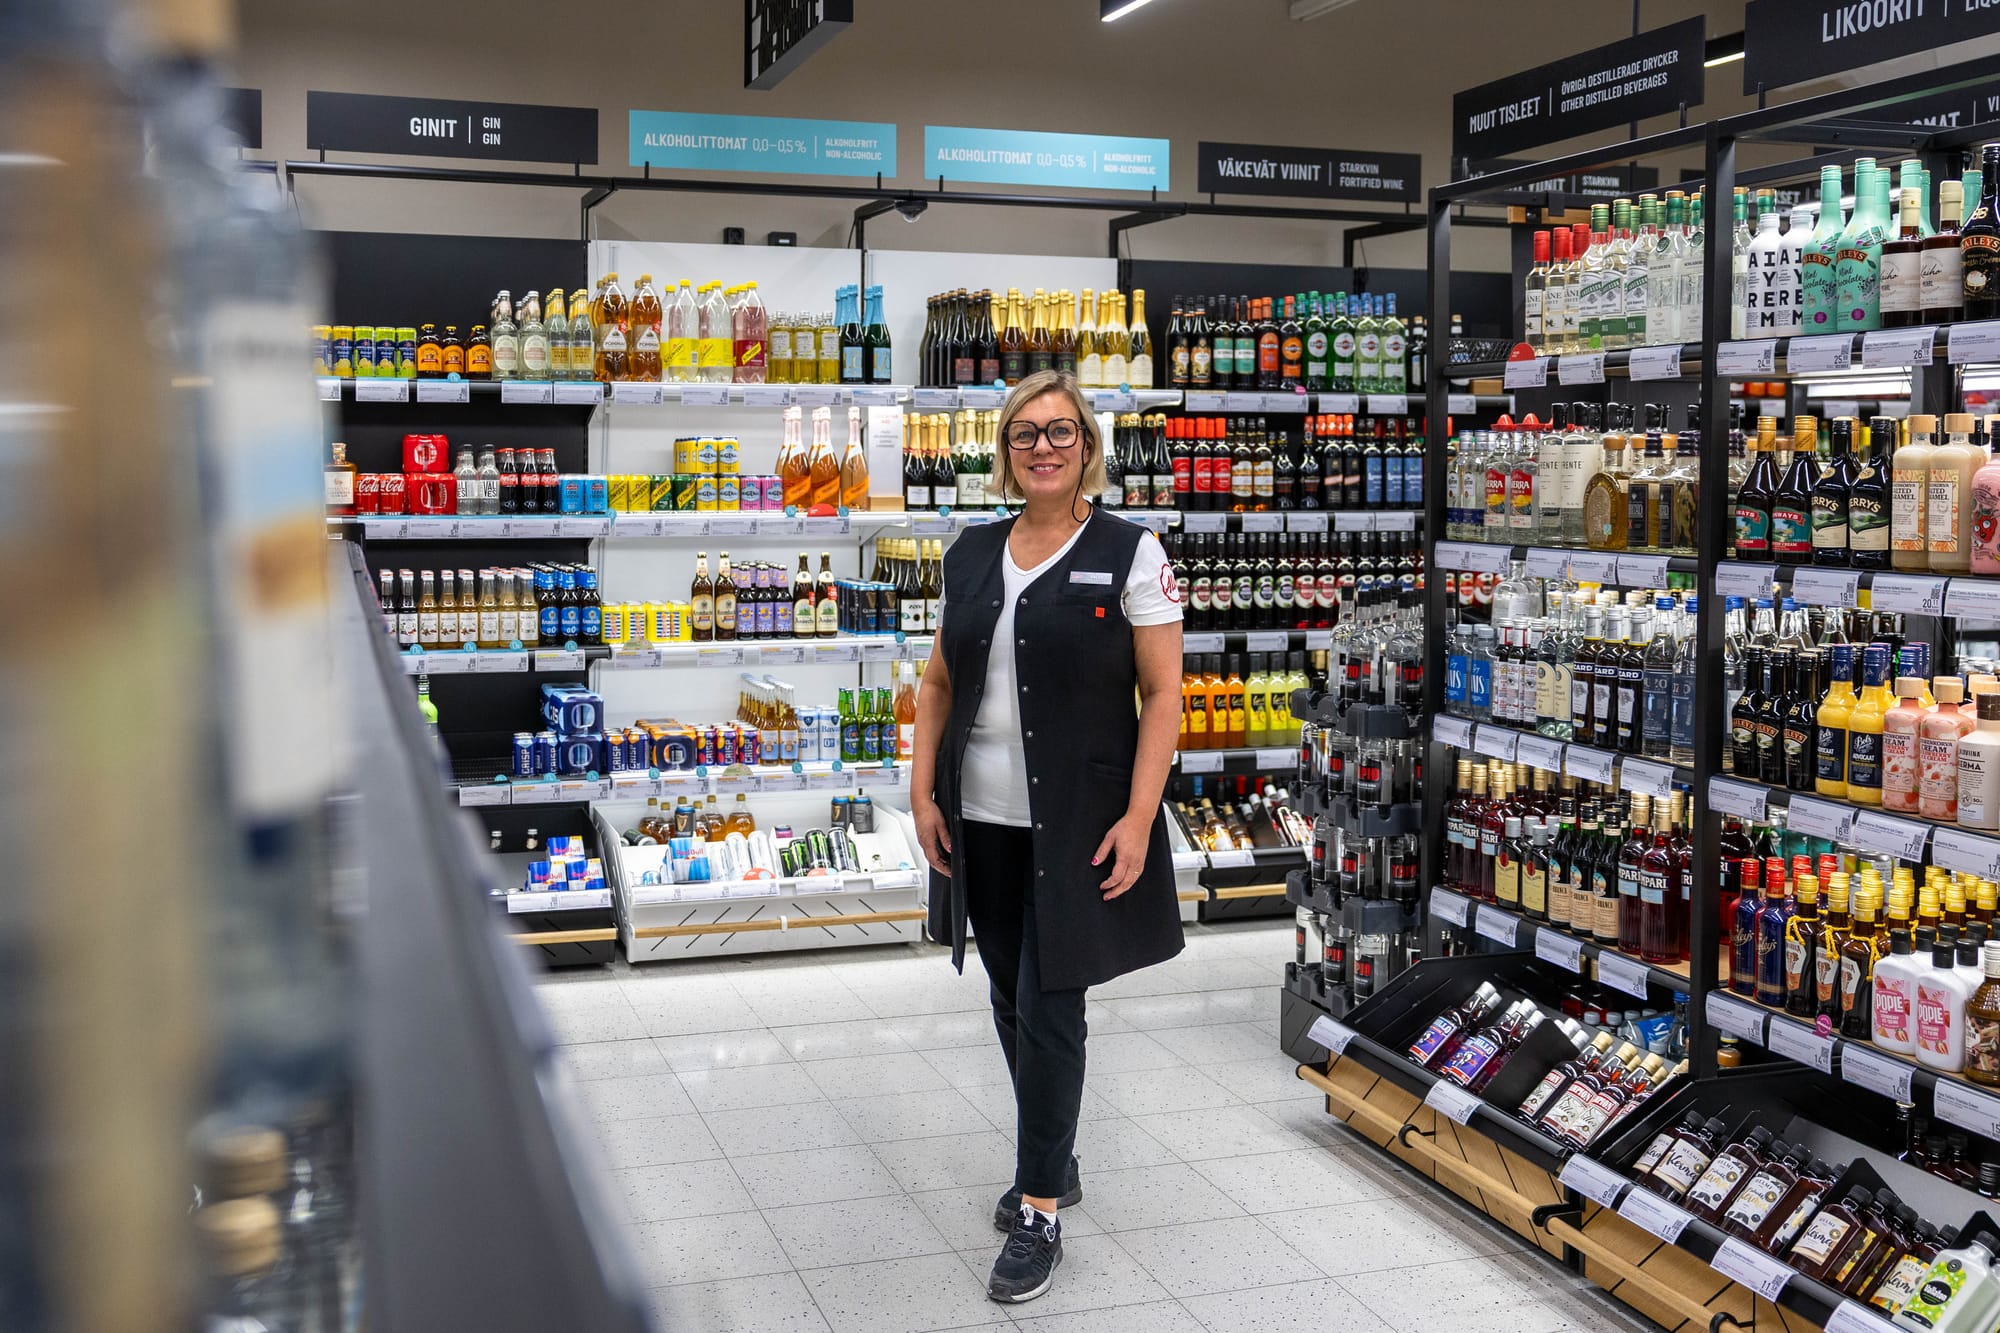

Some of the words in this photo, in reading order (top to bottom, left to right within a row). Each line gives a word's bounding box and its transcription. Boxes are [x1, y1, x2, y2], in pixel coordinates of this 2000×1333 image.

[1561, 76, 1587, 96] ÖVRIGA
[1588, 64, 1642, 88] DESTILLERADE
[1642, 50, 1679, 72] DRYCKER
[1561, 97, 1585, 113] OTHER
[1585, 86, 1622, 106] DISTILLED
[1623, 72, 1668, 95] BEVERAGES
[482, 116, 501, 129] GIN
[1469, 110, 1497, 135] MUUT
[1499, 97, 1541, 126] TISLEET
[410, 117, 457, 138] GINIT
[482, 132, 501, 145] GIN
[644, 133, 747, 151] ALKOHOLITTOMAT
[825, 138, 878, 148] ALKOHOLFRITT
[825, 150, 882, 161] NON-ALCOHOLIC
[938, 149, 1032, 166] ALKOHOLITTOMAT
[1218, 158, 1277, 178] VÄKEVÄT
[1281, 163, 1321, 182] VIINIT
[1339, 162, 1379, 174] STARKVIN
[1339, 176, 1381, 190] FORTIFIED
[1383, 179, 1405, 190] WINE
[521, 748, 530, 774] CRISP
[613, 745, 622, 771] CRISP
[725, 739, 734, 765] CRISP
[1876, 993, 1904, 1013] POPLE
[1919, 1004, 1944, 1025] POPLE
[1667, 1149, 1698, 1181] Kerma
[1805, 1223, 1833, 1247] Kerma
